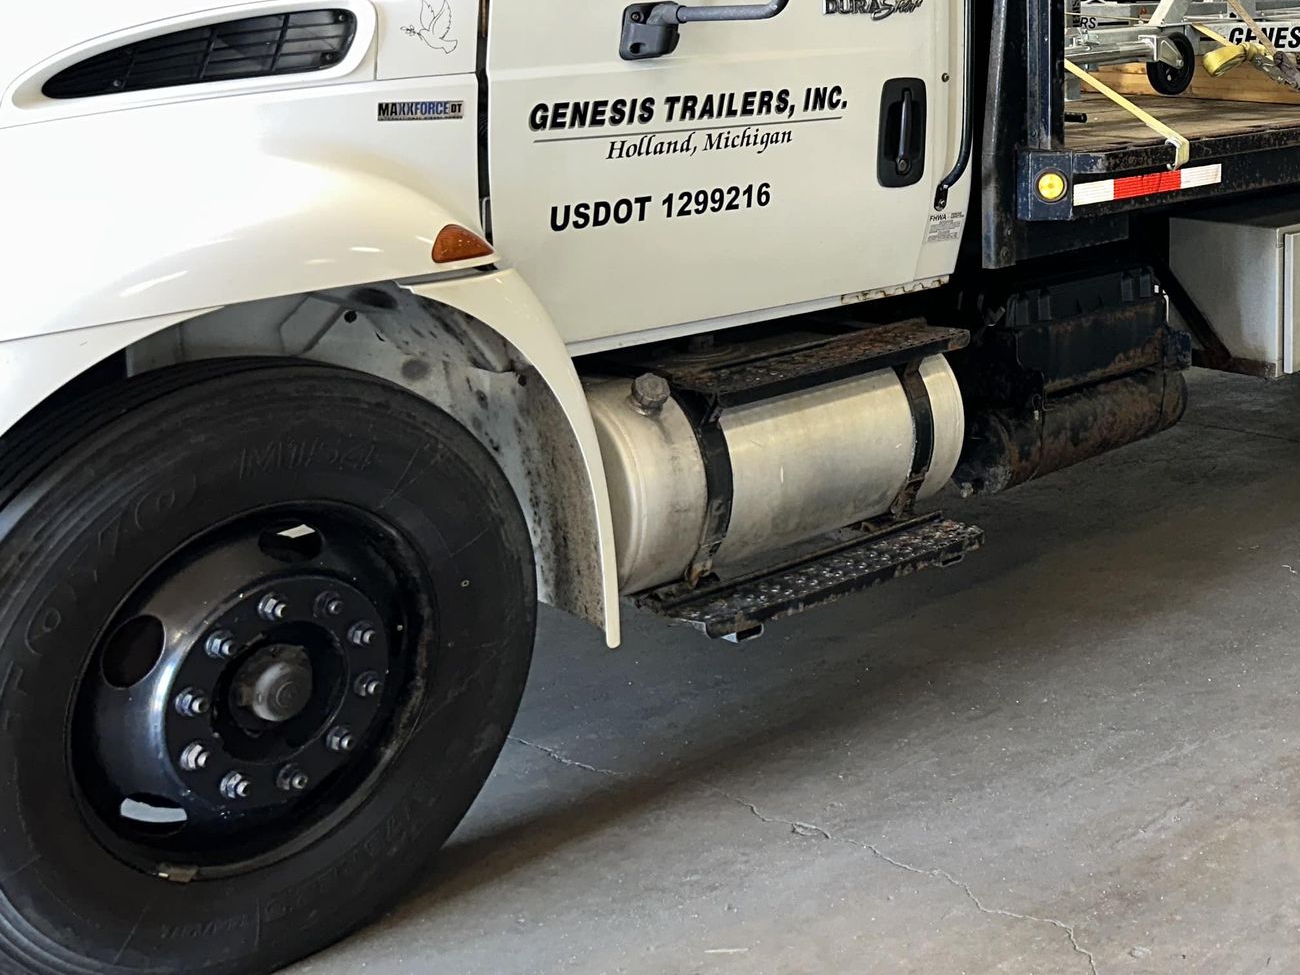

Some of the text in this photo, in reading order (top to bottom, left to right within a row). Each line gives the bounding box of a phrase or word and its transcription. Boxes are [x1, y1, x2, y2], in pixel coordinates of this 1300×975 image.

[378, 101, 463, 117] MAXXFORCE DT
[529, 85, 848, 131] GENESIS TRAILERS, INC.
[605, 127, 793, 159] Holland, Michigan
[550, 182, 771, 232] USDOT 1299216
